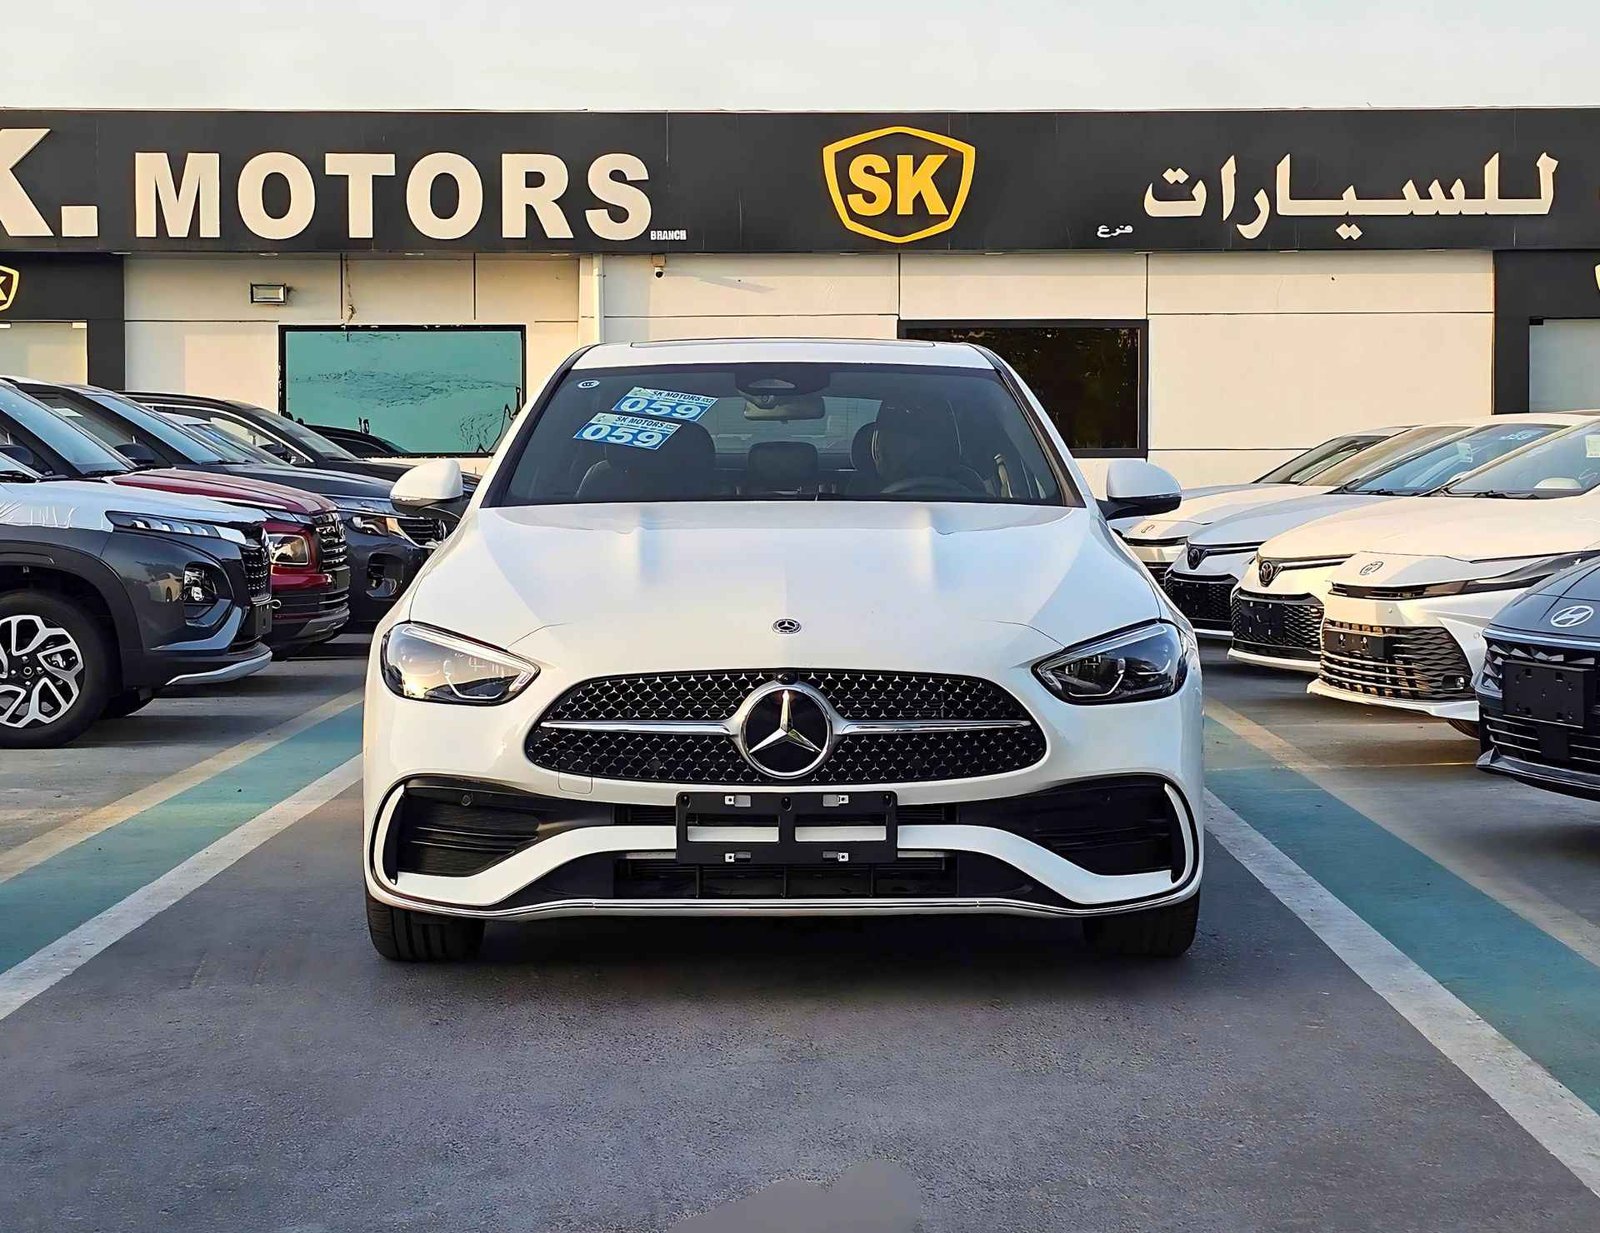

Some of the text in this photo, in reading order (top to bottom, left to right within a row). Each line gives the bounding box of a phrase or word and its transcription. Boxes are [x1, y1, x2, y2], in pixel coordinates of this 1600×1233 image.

[135, 151, 652, 241] MOTORS
[847, 153, 949, 217] SK
[1143, 152, 1558, 240] للسيارات
[650, 229, 687, 241] BRANCH
[665, 391, 702, 401] MOTORS
[620, 397, 701, 419] 059
[615, 415, 628, 423] SK
[629, 416, 666, 428] MOTORS
[582, 424, 663, 447] 059
